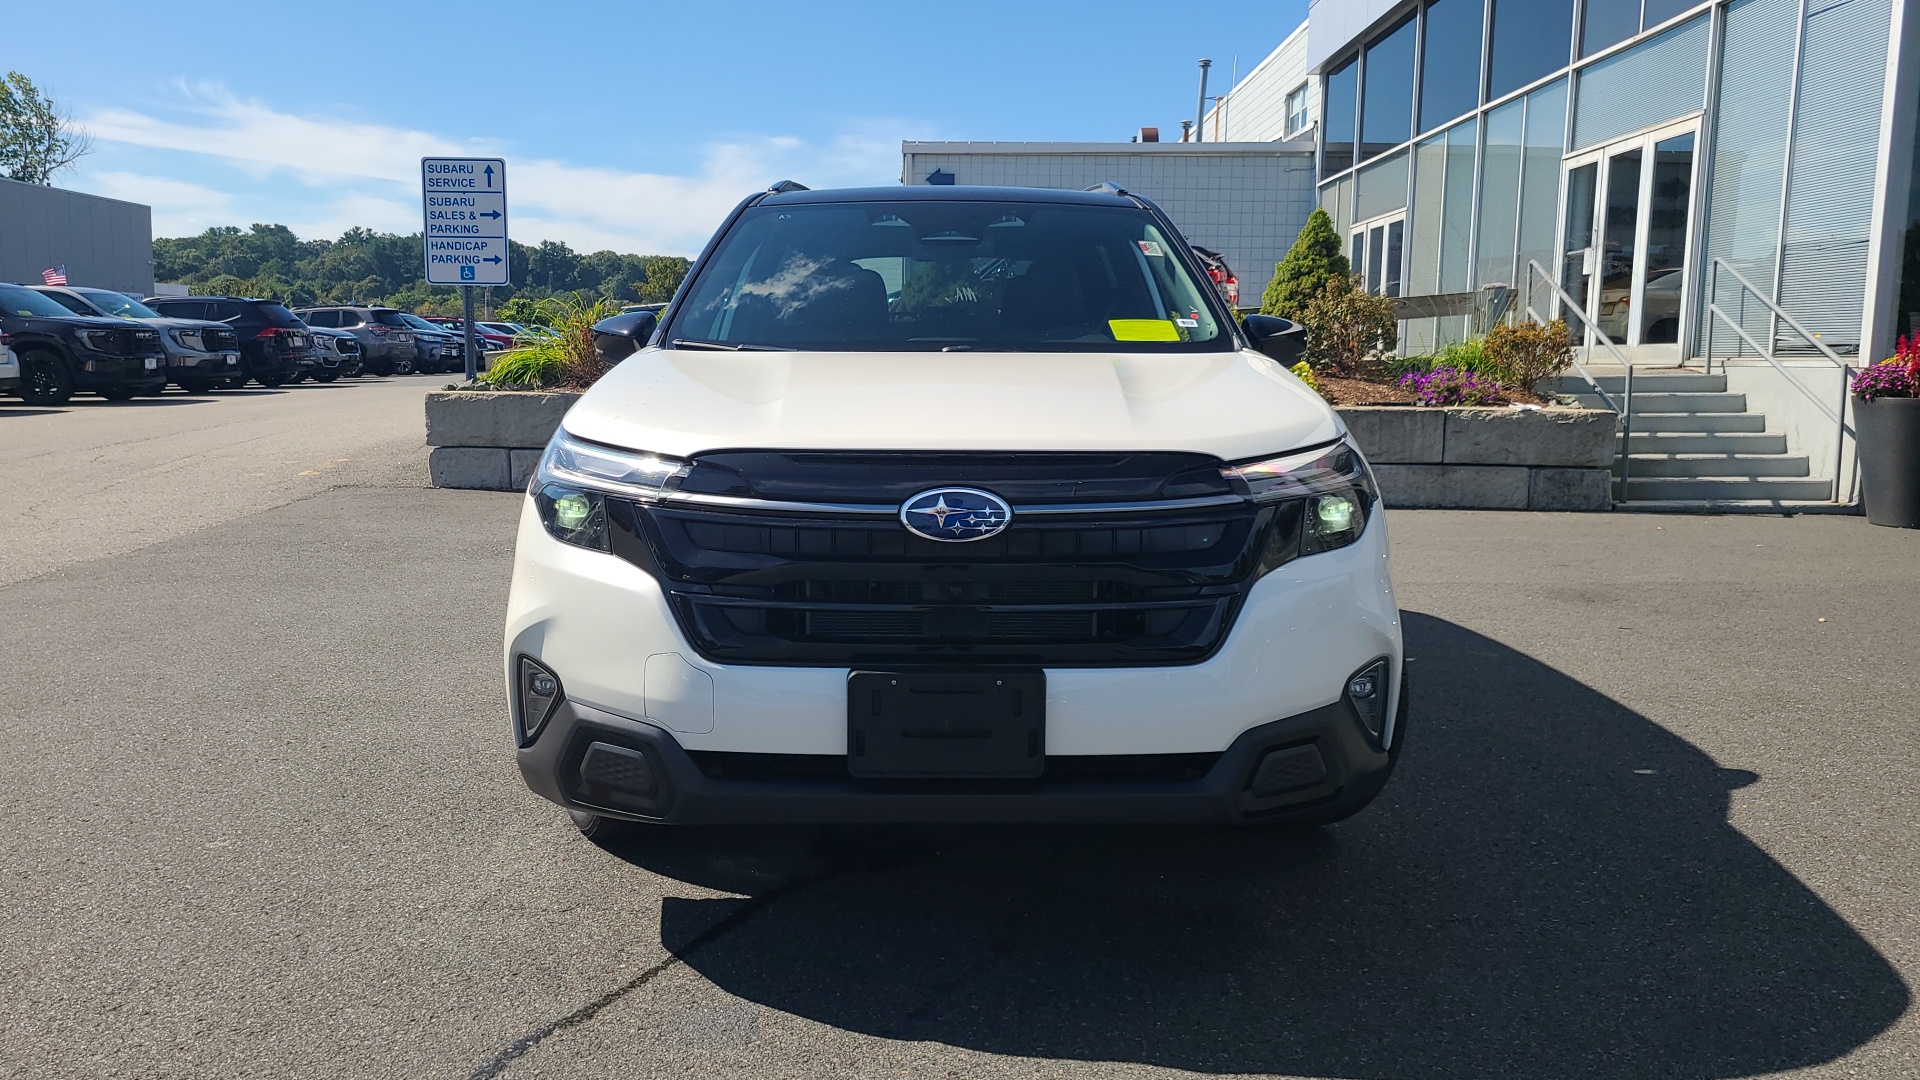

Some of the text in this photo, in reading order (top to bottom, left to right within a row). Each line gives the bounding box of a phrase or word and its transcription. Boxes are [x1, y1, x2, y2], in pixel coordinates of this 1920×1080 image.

[427, 164, 474, 174] SUBARU
[428, 177, 476, 188] SERVICE
[429, 197, 475, 207] SUBARU
[429, 210, 477, 220] SALES &
[430, 224, 480, 234] PARKING
[431, 241, 488, 251] HANDICAP
[431, 254, 480, 264] PARKING
